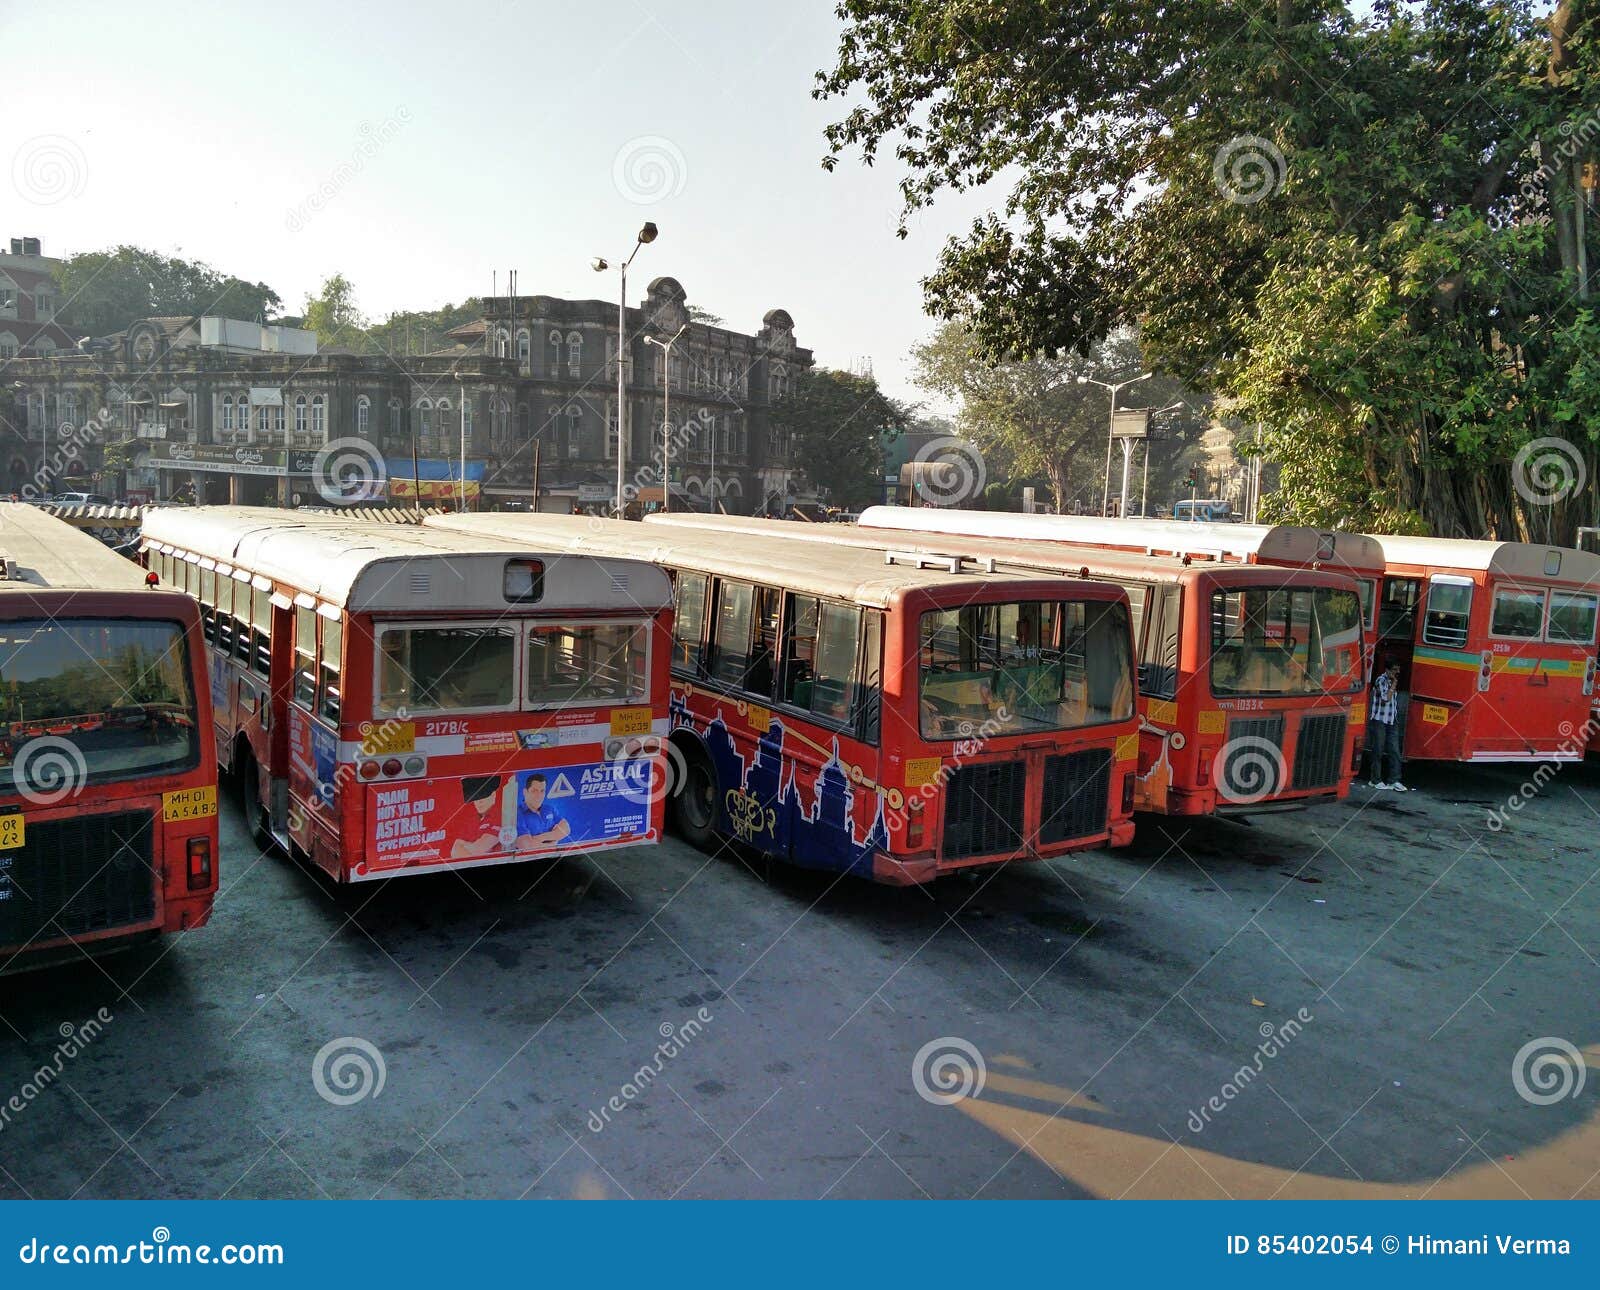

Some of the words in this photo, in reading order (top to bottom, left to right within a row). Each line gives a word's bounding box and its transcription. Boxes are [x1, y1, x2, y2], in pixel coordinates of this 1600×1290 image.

[580, 763, 646, 785] ASTRAL
[580, 782, 615, 794] PIPES
[171, 792, 189, 805] MH
[164, 809, 180, 821] LA
[375, 815, 427, 841] ASTRAL
